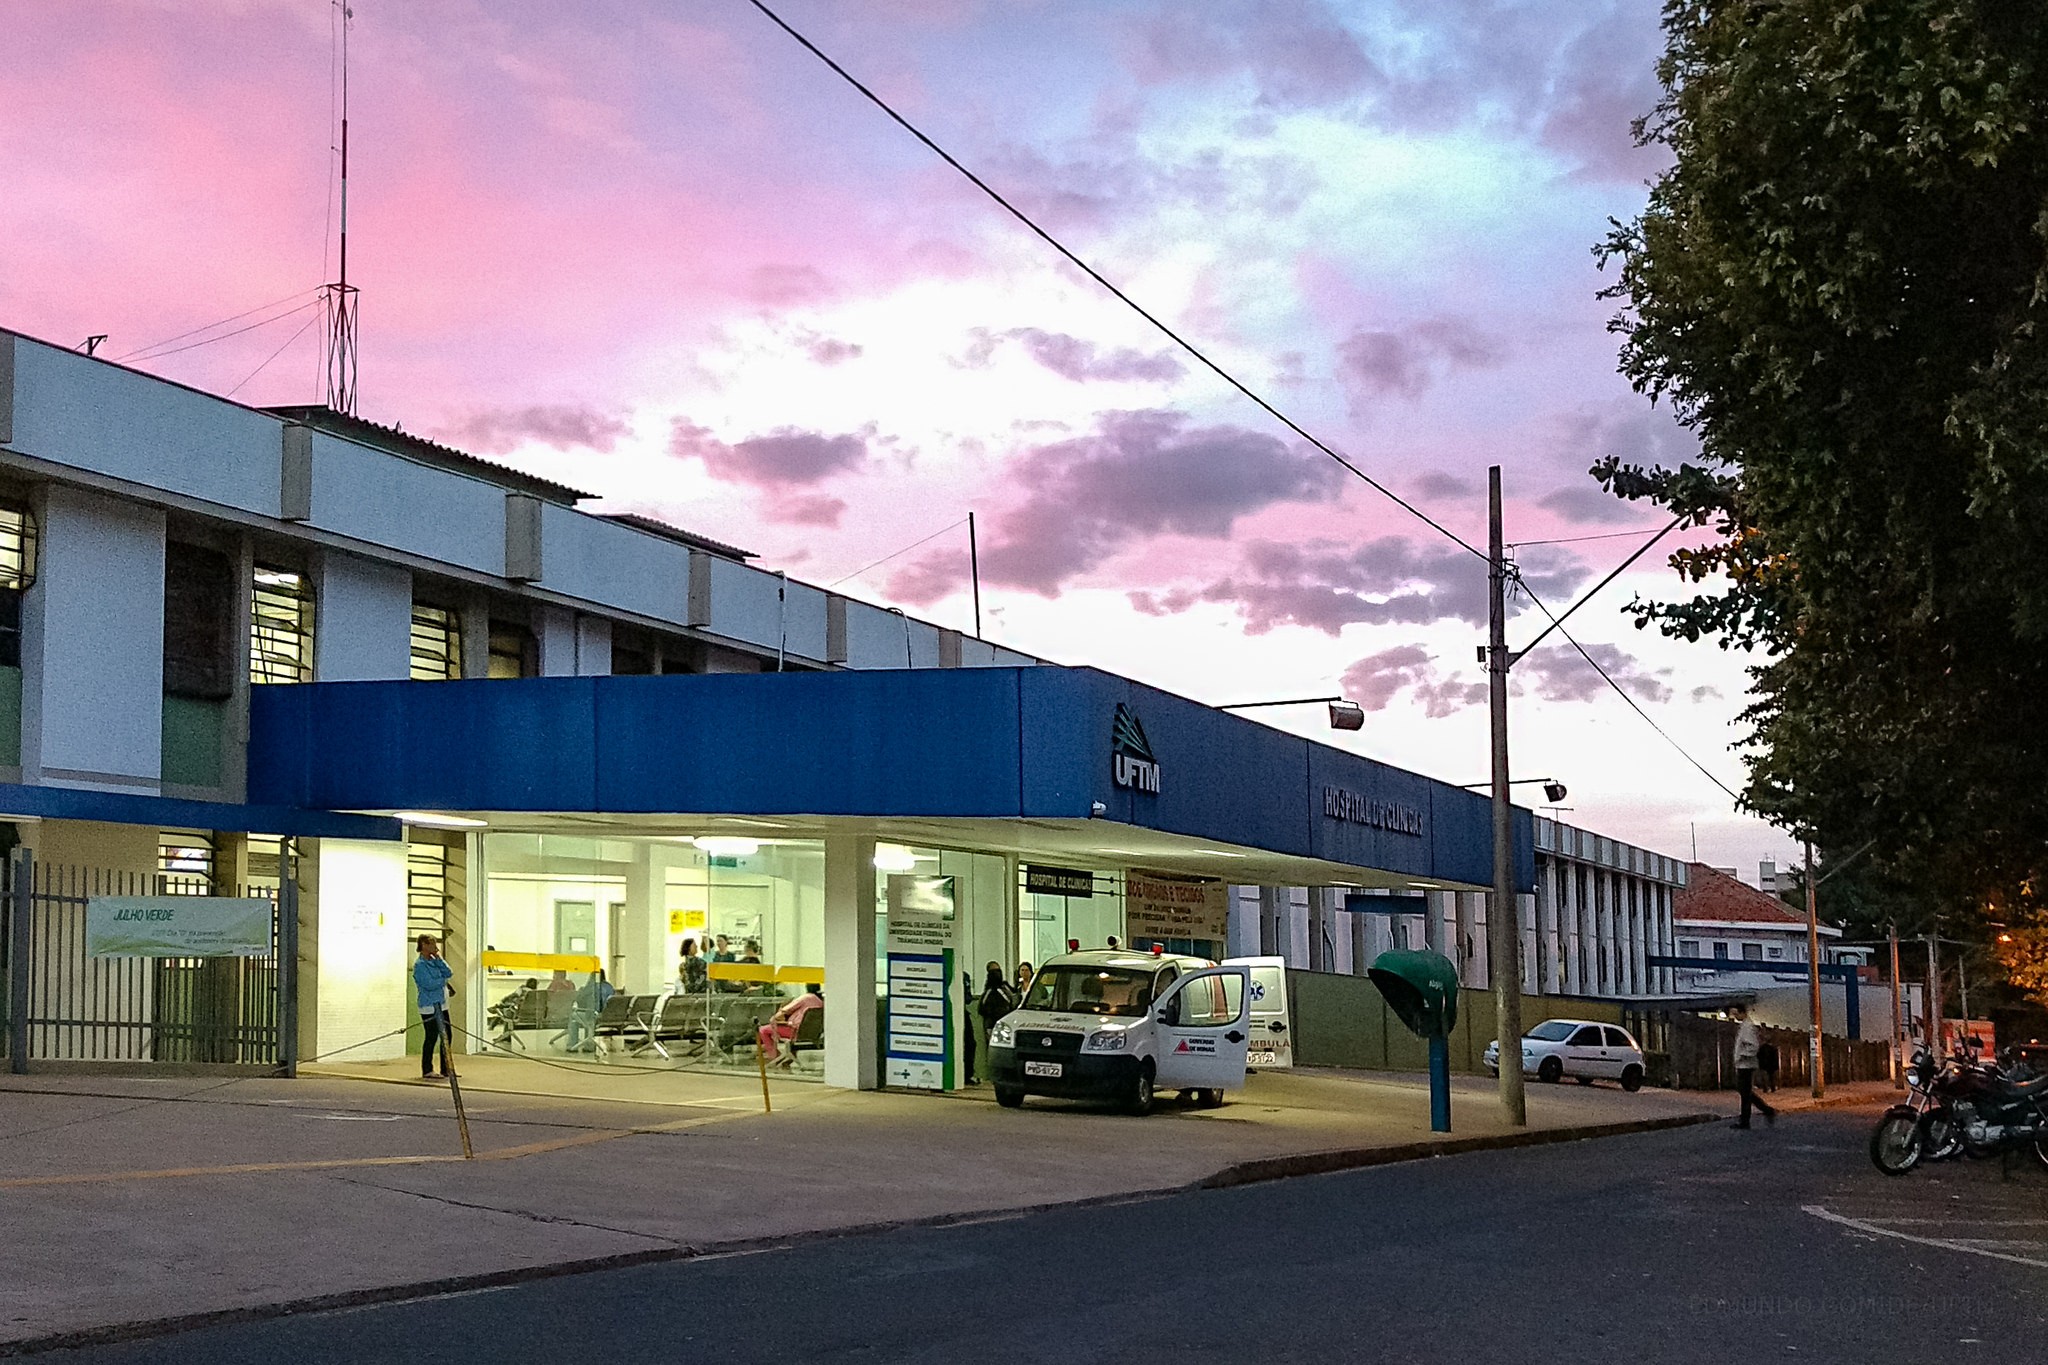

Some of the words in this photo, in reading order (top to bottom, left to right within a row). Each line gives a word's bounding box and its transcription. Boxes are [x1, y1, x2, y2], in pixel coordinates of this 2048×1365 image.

[1115, 753, 1160, 793] UFTM
[1324, 786, 1371, 824] HOSPITAL
[1029, 872, 1058, 888] HOSPITAL
[1058, 875, 1067, 889] DE
[113, 908, 145, 922] JULHO
[145, 908, 175, 921] VERDE
